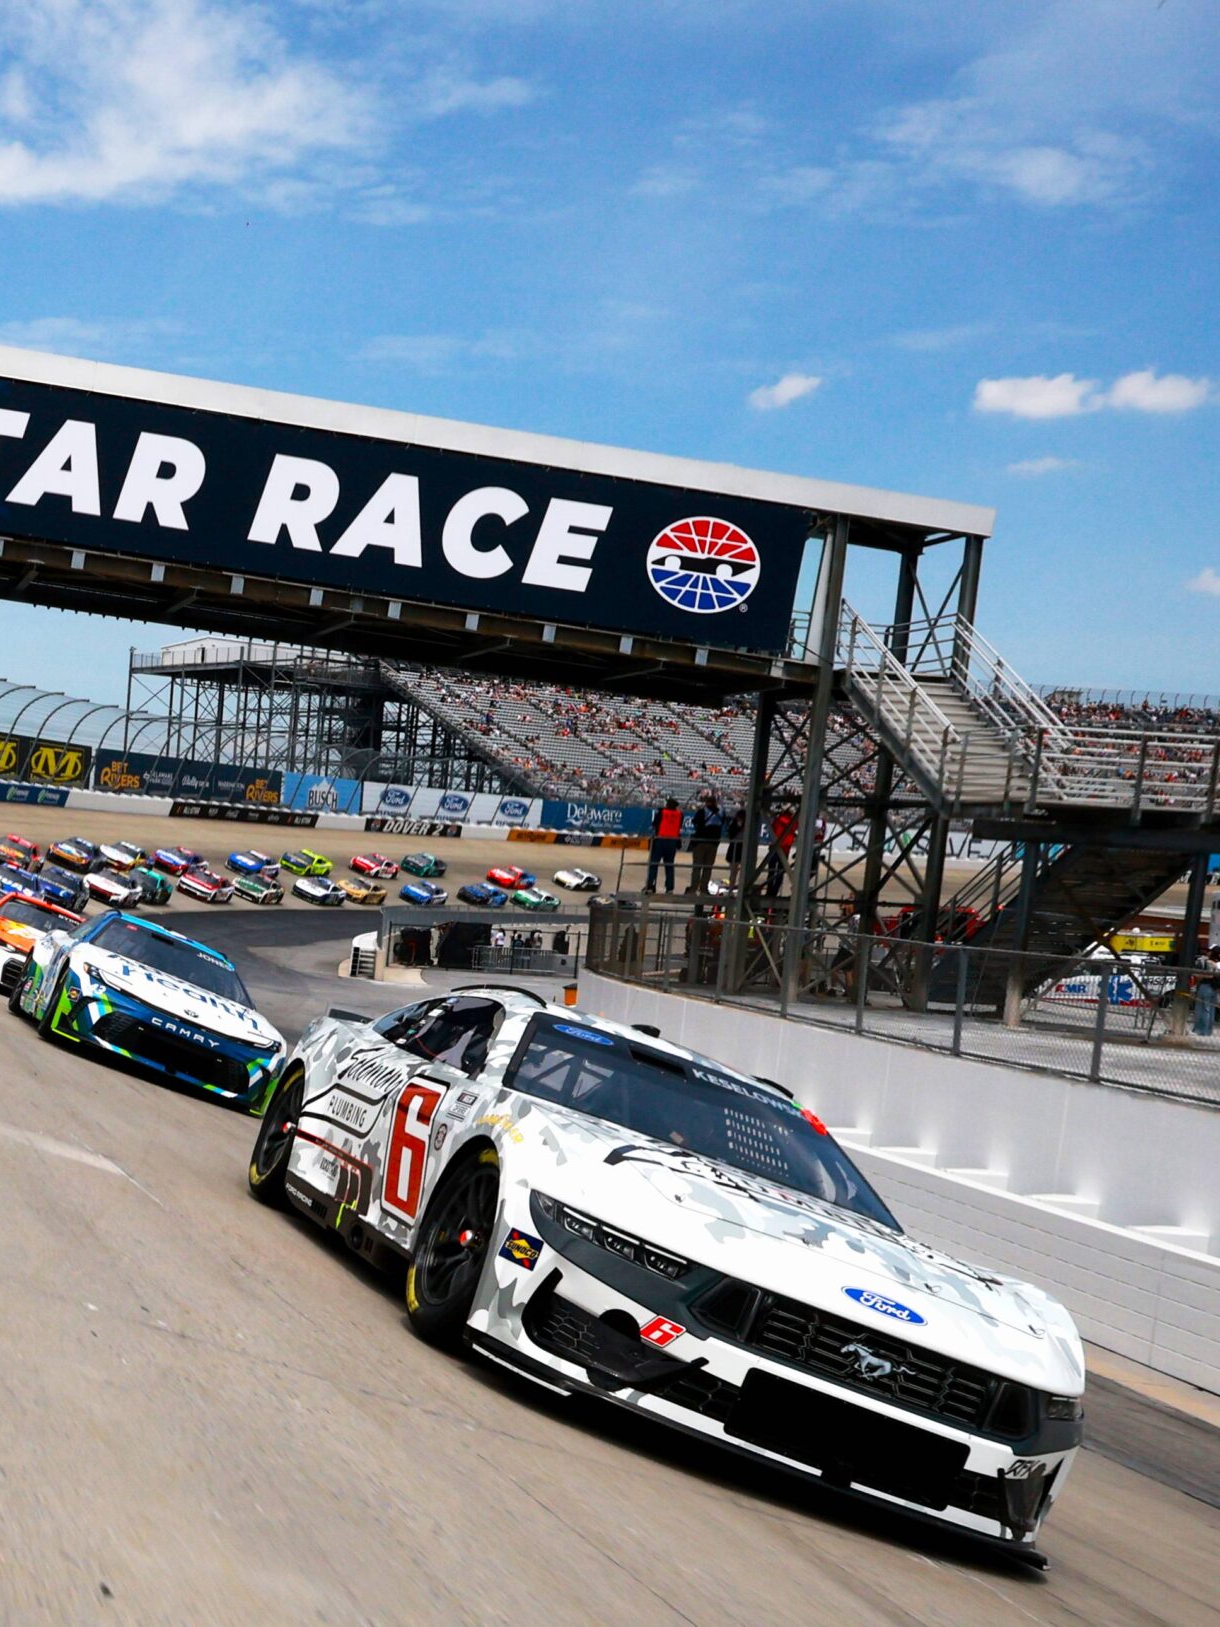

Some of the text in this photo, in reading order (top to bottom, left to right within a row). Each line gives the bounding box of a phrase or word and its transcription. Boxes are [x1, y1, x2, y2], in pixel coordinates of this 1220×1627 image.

[246, 453, 614, 593] RACE
[111, 761, 128, 773] BET
[100, 767, 140, 790] RIVERS
[246, 784, 279, 803] RIVERS
[308, 790, 338, 809] BUSCH
[385, 790, 406, 806] Ford
[443, 796, 464, 811] Ford
[504, 802, 525, 817] Ford
[567, 802, 623, 825] Delaware
[383, 820, 444, 836] DOVER 2
[151, 1016, 220, 1048] CAMRY
[327, 1094, 368, 1128] PLUMBING
[383, 1082, 444, 1220] 6
[506, 1239, 538, 1261] SUNOCO
[859, 1290, 912, 1322] Ford
[639, 1315, 686, 1348] 6
